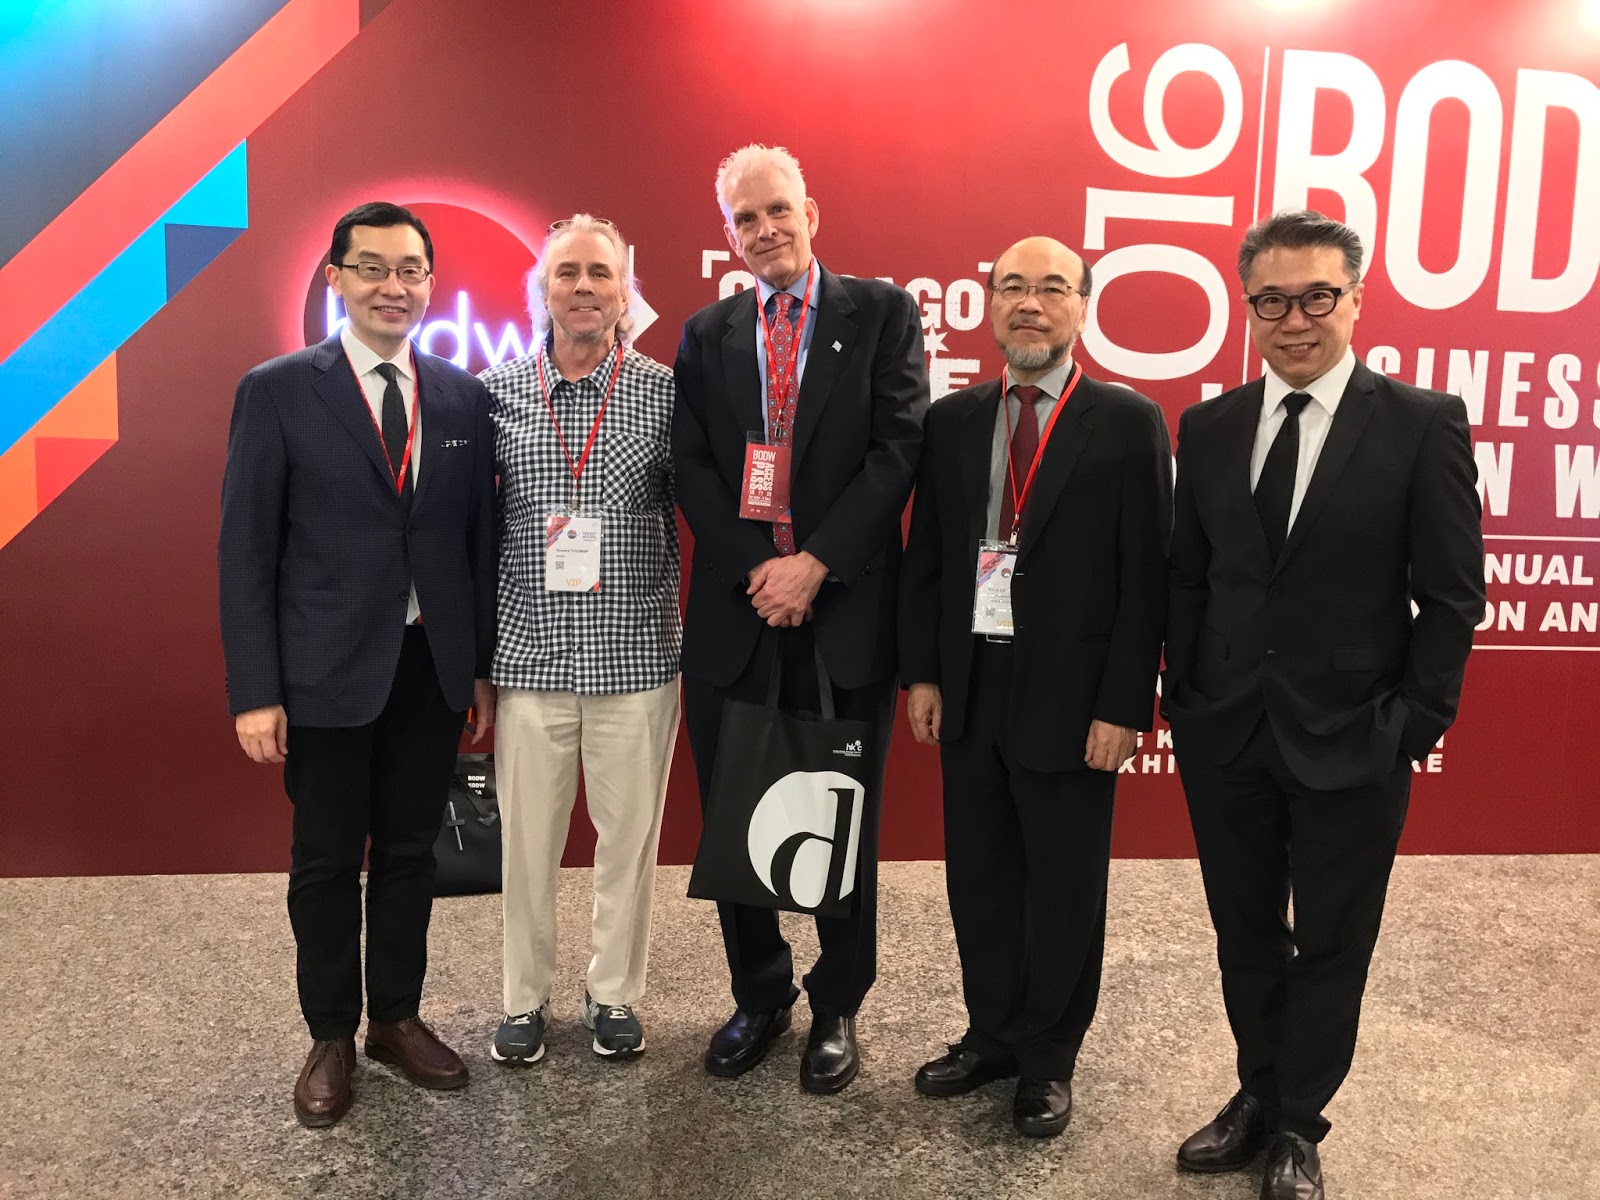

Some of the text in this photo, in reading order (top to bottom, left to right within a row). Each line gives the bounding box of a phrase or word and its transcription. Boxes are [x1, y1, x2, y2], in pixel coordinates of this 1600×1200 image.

[1081, 42, 1243, 390] 016
[753, 449, 776, 461] BODW
[566, 579, 581, 587] VIP
